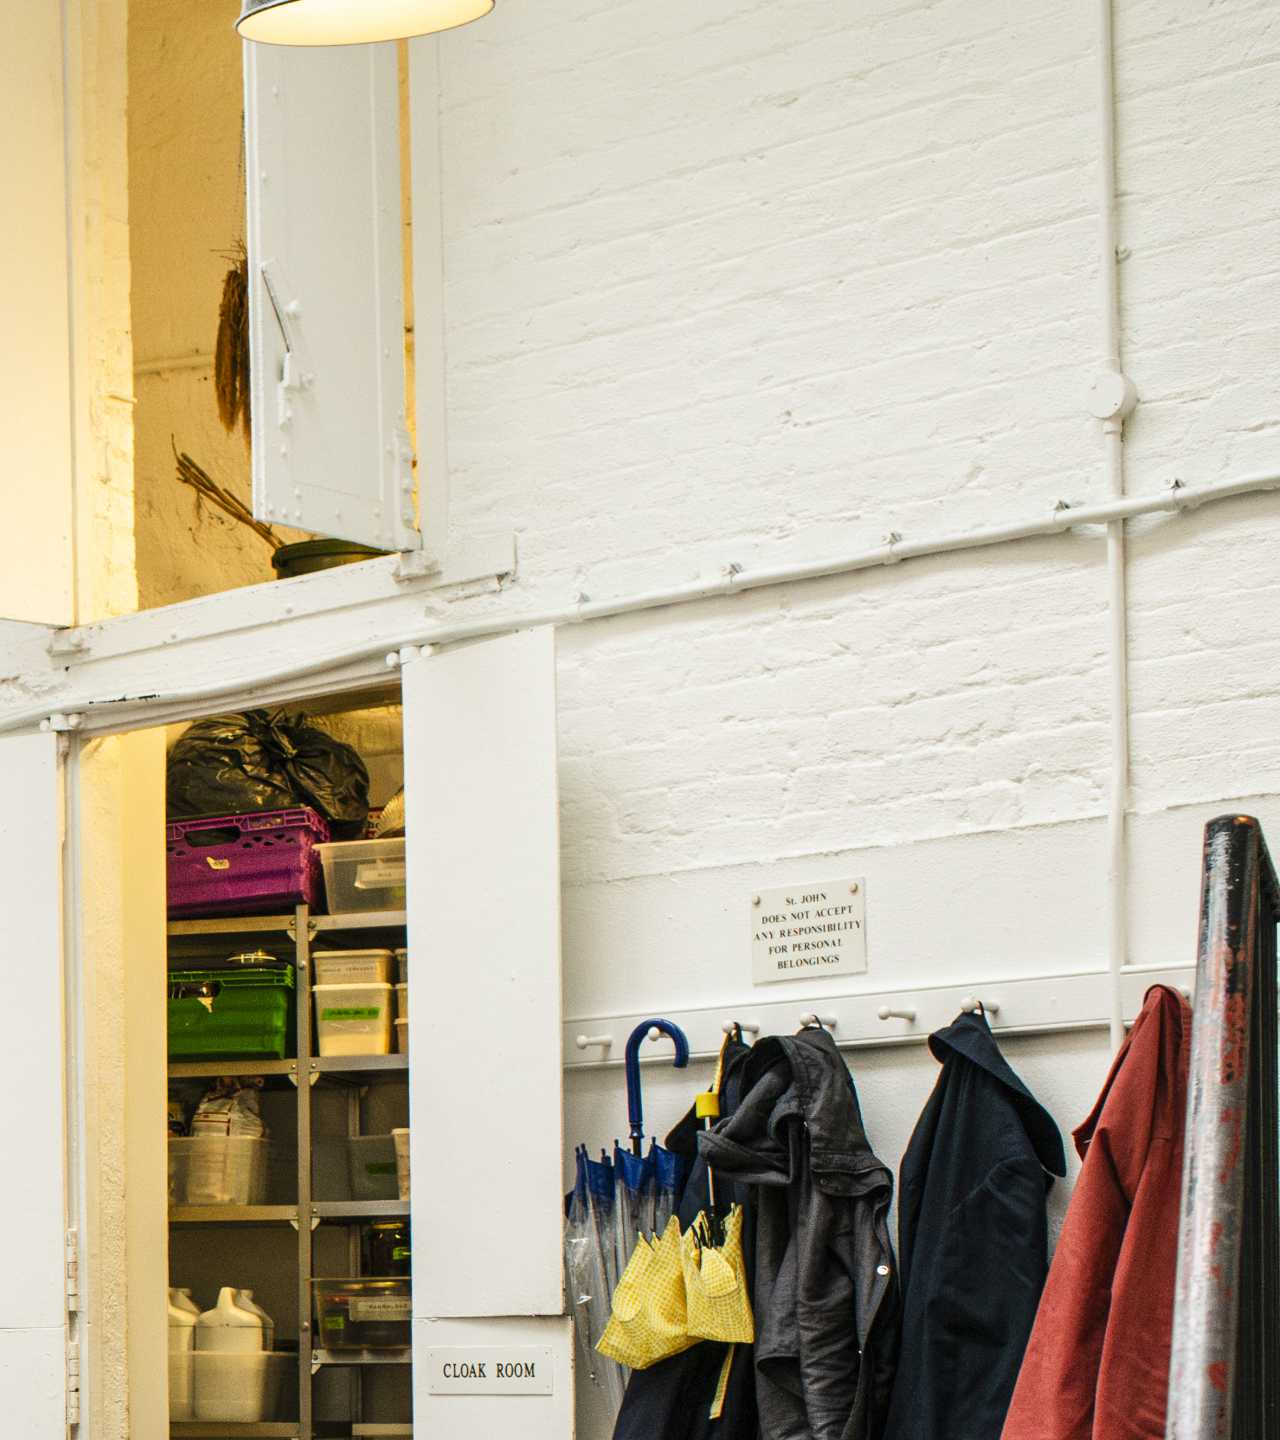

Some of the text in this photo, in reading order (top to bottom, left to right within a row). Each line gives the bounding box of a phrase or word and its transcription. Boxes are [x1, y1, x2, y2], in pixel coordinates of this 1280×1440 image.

[800, 892, 827, 904] JOHN
[762, 904, 853, 925] DOES NOT ACCEPT
[753, 919, 861, 942] ANY RESPONSIBILITY
[768, 938, 842, 955] FOR PERSONAL
[777, 954, 840, 970] BELONGINGS
[442, 1362, 535, 1378] CLOAK ROOM
